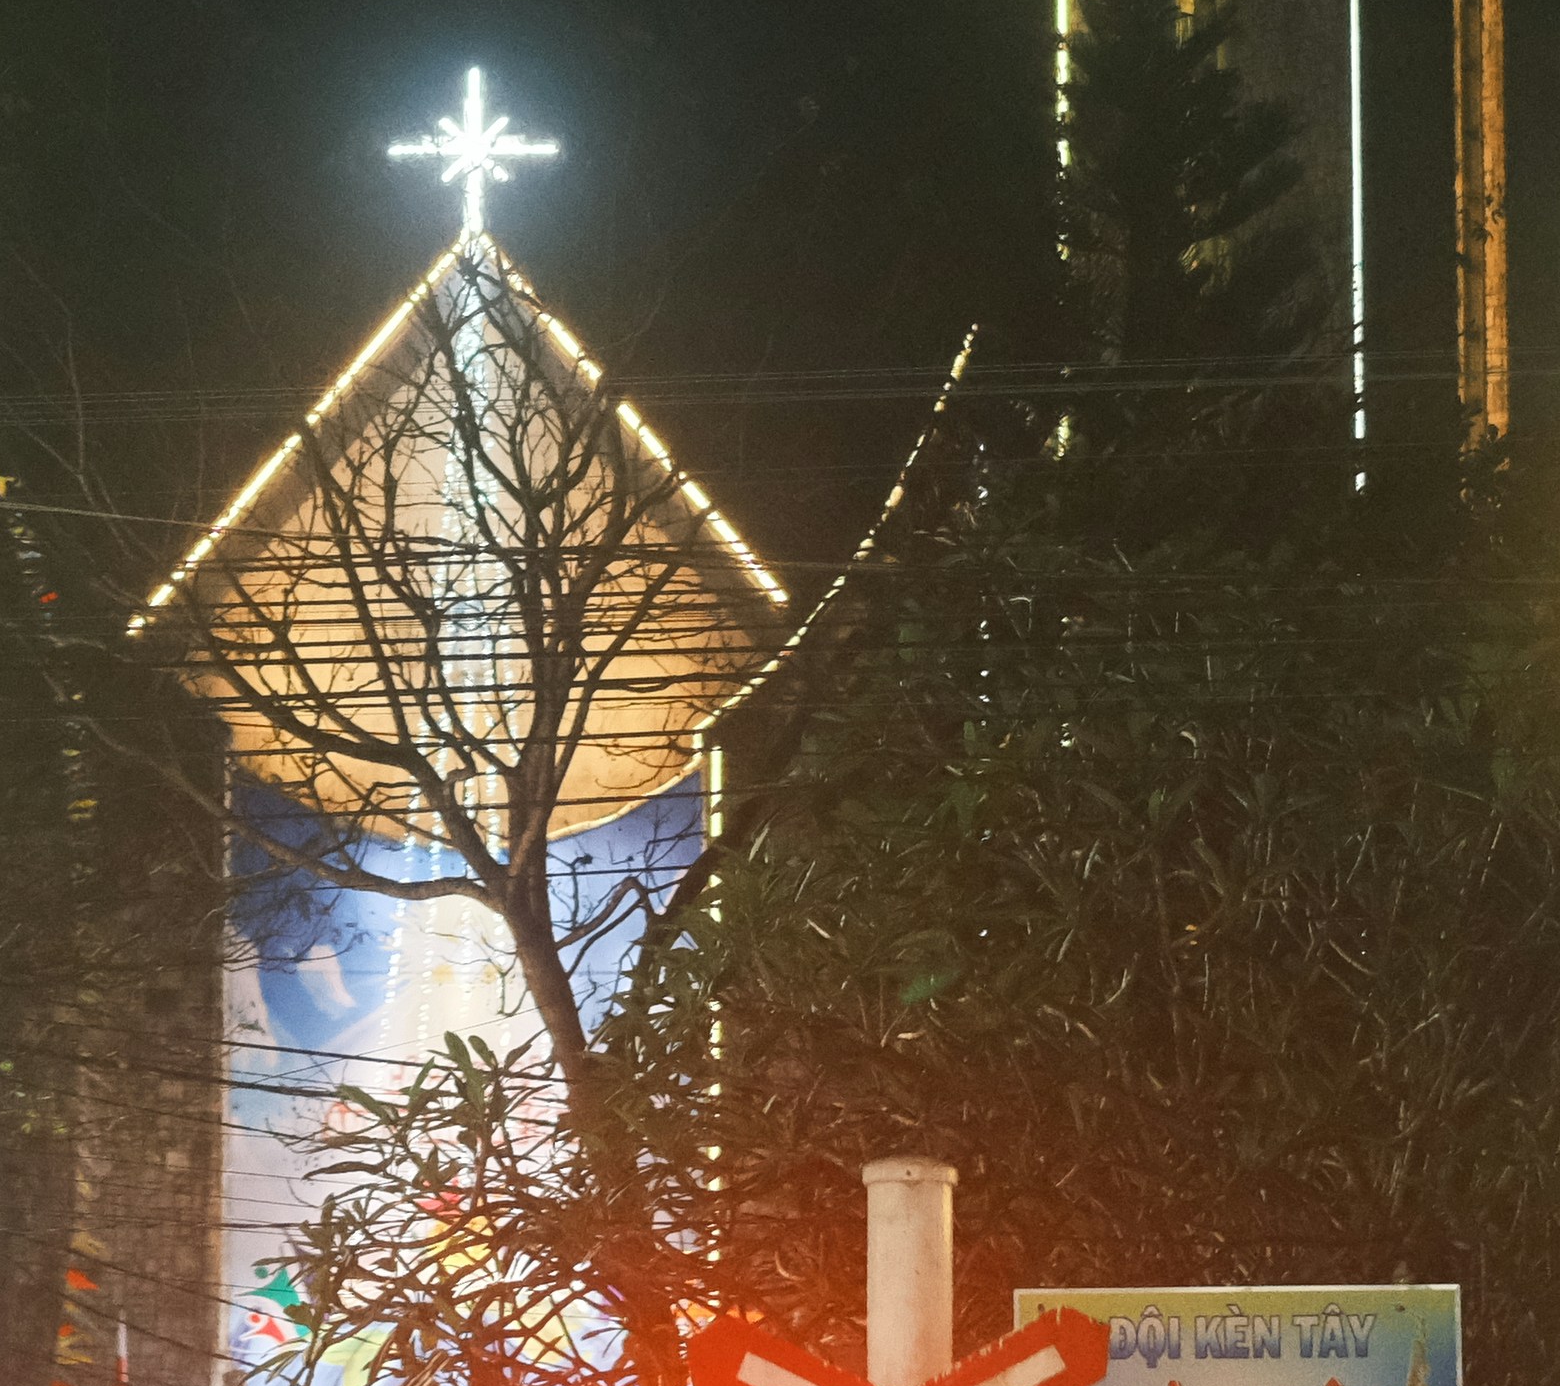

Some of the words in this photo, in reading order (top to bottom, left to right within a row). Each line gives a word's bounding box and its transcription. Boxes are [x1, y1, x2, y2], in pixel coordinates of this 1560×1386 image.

[1108, 1304, 1179, 1369] ĐỘI
[1194, 1303, 1282, 1360] KÈN
[1293, 1302, 1377, 1360] TÂY
